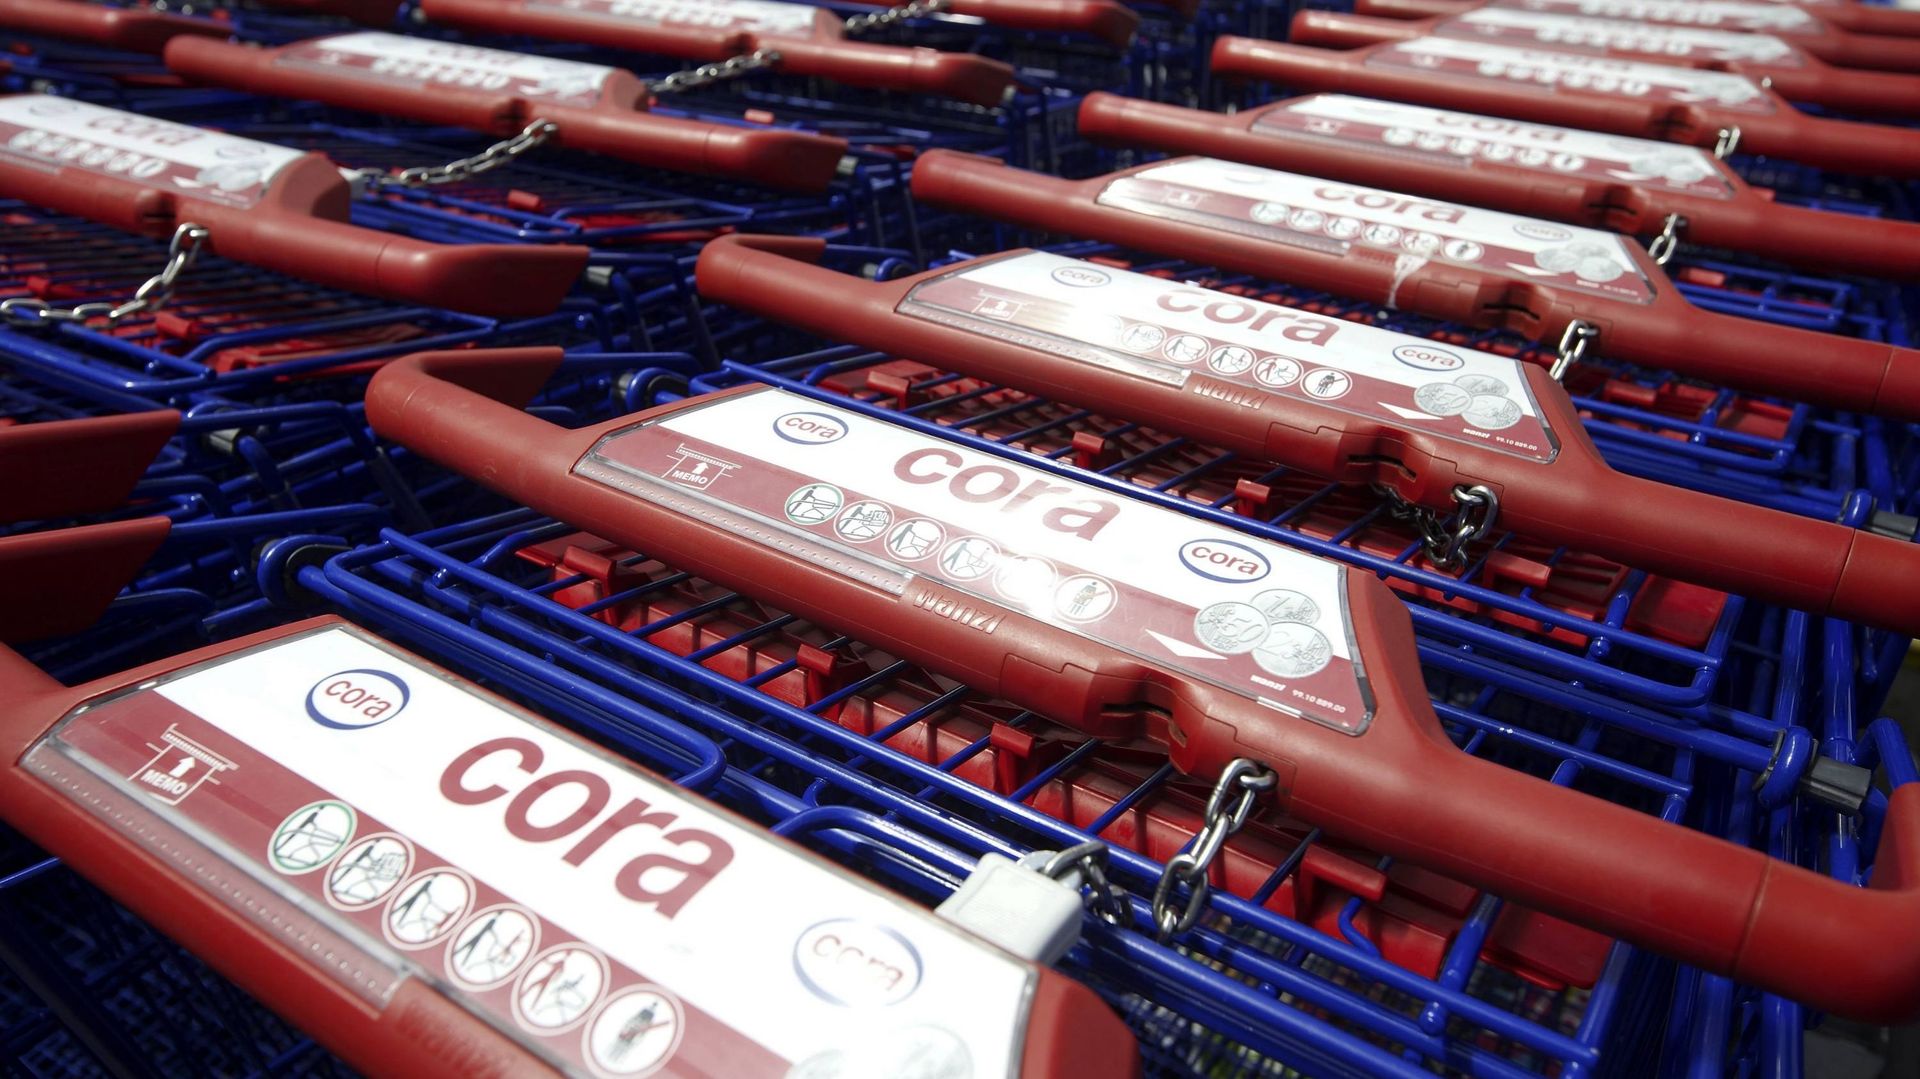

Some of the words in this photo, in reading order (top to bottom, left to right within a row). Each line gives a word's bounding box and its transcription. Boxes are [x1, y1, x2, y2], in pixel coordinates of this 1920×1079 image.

[1314, 187, 1467, 224] cora
[1156, 289, 1340, 347] cora
[1402, 349, 1456, 367] cora
[785, 417, 838, 439] cora
[672, 470, 708, 485] MEMO
[893, 447, 1121, 541] cora
[1191, 546, 1260, 576] cora
[325, 680, 392, 719] cora
[141, 769, 188, 796] MEMO
[439, 736, 736, 921] cora
